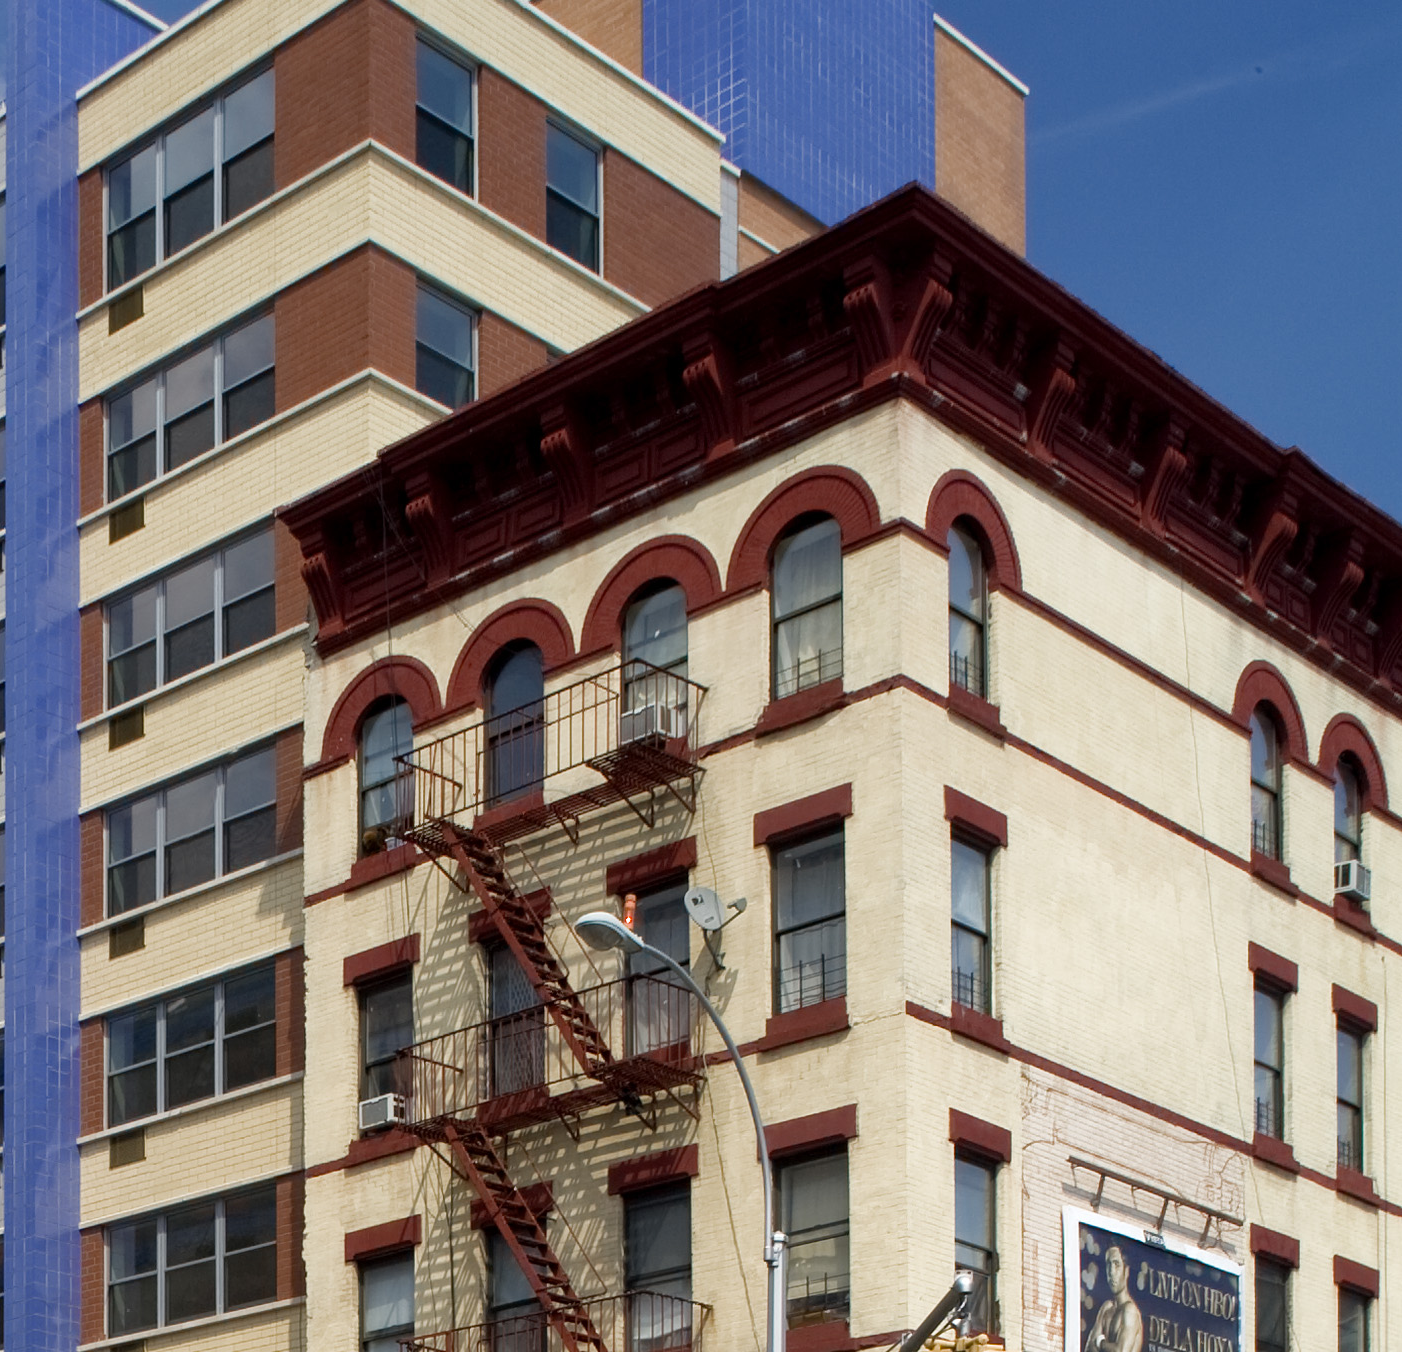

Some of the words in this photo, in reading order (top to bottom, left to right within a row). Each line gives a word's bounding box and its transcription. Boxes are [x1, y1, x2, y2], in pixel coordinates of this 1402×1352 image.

[1148, 1267, 1181, 1303] LIVE
[1181, 1279, 1201, 1310] ON
[1203, 1288, 1236, 1321] HBO!
[1149, 1315, 1170, 1346] DE
